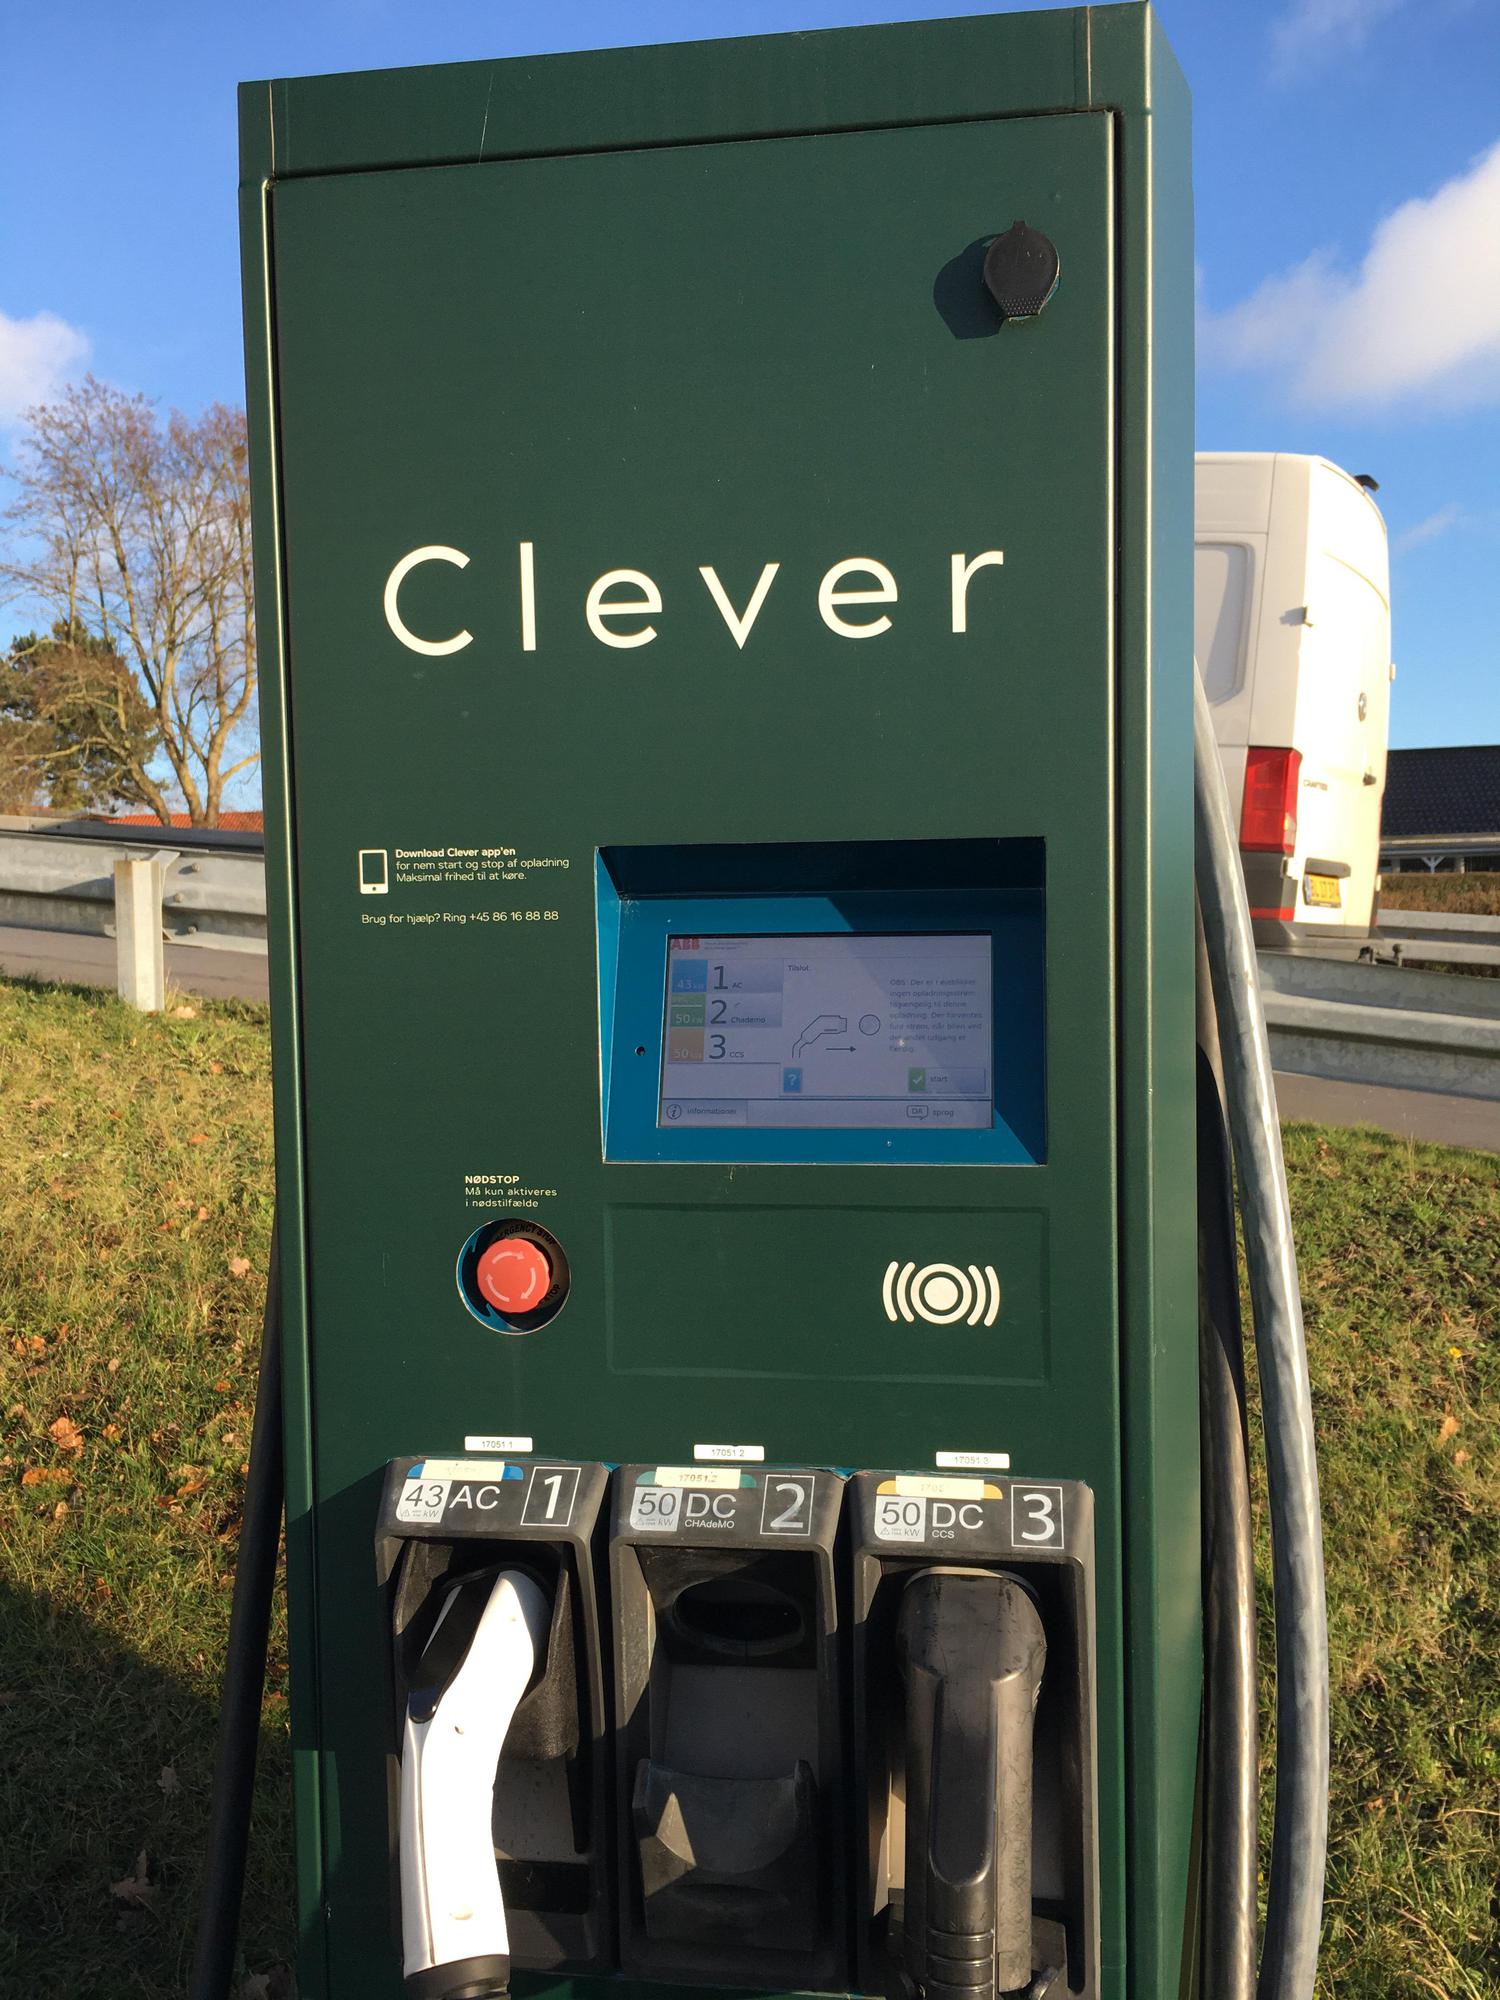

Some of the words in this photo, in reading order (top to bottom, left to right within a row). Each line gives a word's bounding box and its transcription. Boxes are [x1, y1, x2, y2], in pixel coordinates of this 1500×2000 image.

[384, 541, 1004, 656] Clever
[395, 848, 445, 859] Download
[447, 847, 479, 858] Clever
[481, 847, 516, 860] app'en
[396, 861, 410, 871] for
[413, 862, 436, 870] nem
[438, 861, 463, 870] start
[465, 861, 479, 872] og
[481, 860, 505, 871] stop
[507, 859, 518, 869] af
[520, 858, 570, 869] opladning
[396, 872, 443, 882] Maksimal
[445, 871, 475, 881] frihed
[477, 871, 487, 881] til
[489, 872, 500, 881] at
[502, 871, 527, 881] køre.
[361, 914, 386, 926] Brug
[389, 914, 404, 924] for
[407, 913, 441, 926] hjælp?
[443, 912, 467, 925] Ring
[469, 912, 490, 922] +45
[492, 911, 508, 921] 86
[510, 911, 523, 921] 16
[525, 911, 541, 921] 88
[543, 911, 559, 921] 88
[671, 938, 700, 950] ABB
[713, 965, 729, 990] 1
[710, 1000, 727, 1024] 2
[675, 1014, 690, 1024] 50
[708, 1034, 726, 1059] 3
[465, 1175, 520, 1184] NØDSTOP
[465, 1186, 481, 1196] Må
[485, 1187, 504, 1196] kun
[507, 1187, 558, 1196] aktiveres
[465, 1199, 469, 1207] i
[472, 1199, 539, 1208] nødstilfælde
[481, 1440, 506, 1449] 17051
[711, 1448, 737, 1457] 17051
[954, 1456, 981, 1465] 17051
[405, 1484, 445, 1507] 43
[448, 1485, 501, 1510] AC
[544, 1475, 563, 1519] 1
[638, 1492, 678, 1516] 50
[686, 1493, 737, 1519] DC
[770, 1482, 806, 1529] 2
[423, 1509, 441, 1518] kW
[881, 1501, 921, 1526] 50
[932, 1502, 984, 1530] DC
[1021, 1493, 1056, 1541] 3
[657, 1518, 675, 1527] kW
[684, 1519, 735, 1529] CHAdeMO
[904, 1528, 920, 1538] kW
[931, 1529, 955, 1539] CCS
